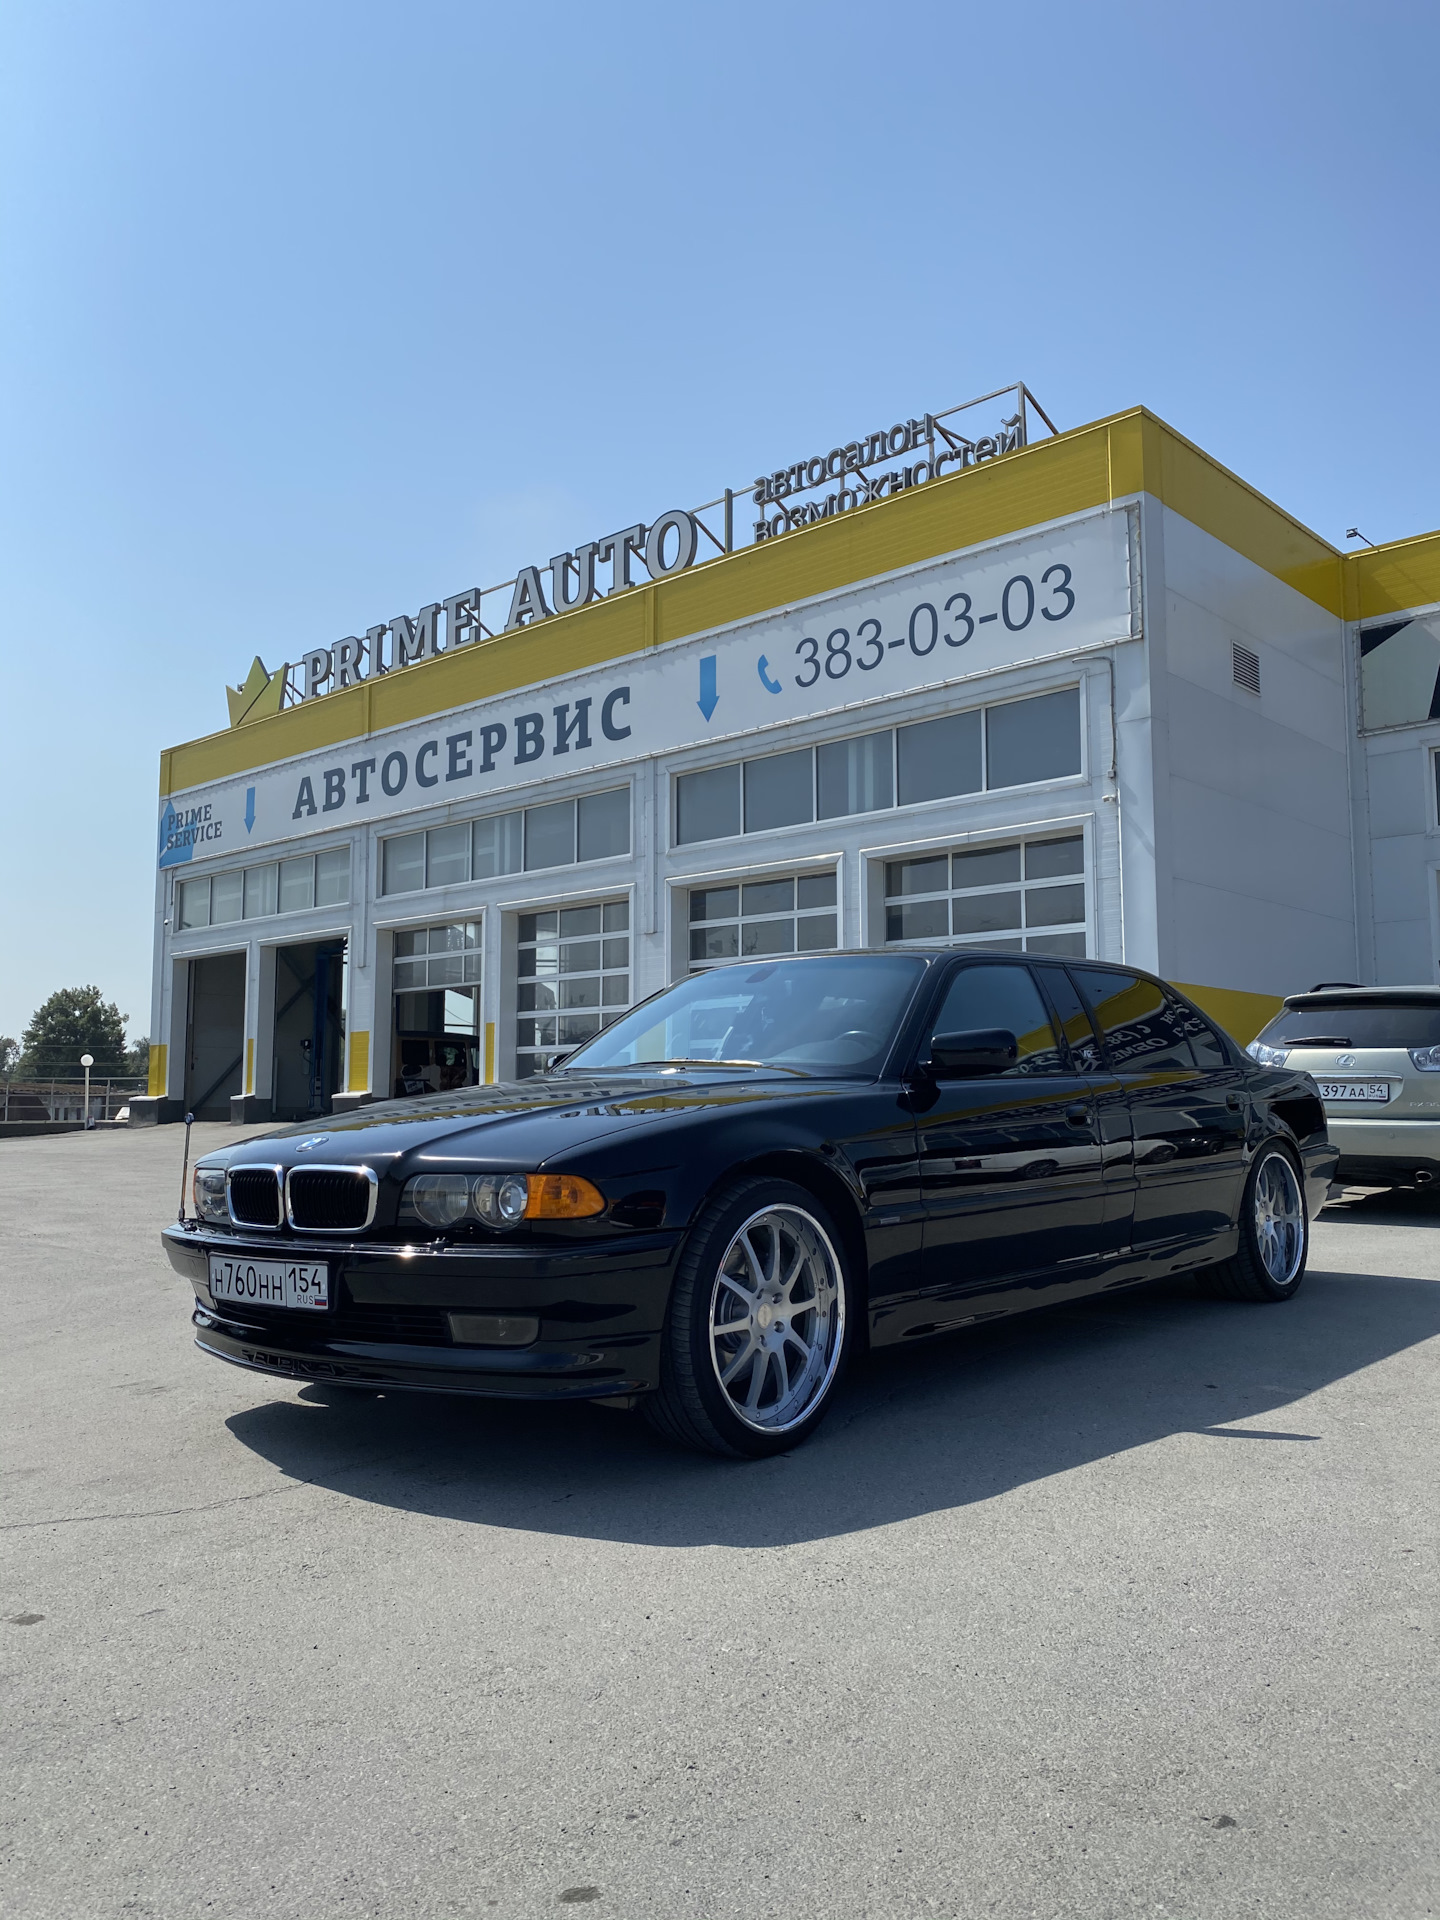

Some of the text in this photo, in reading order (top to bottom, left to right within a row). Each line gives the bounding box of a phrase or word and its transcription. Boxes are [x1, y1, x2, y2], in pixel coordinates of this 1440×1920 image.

[753, 413, 936, 504] автосалон
[753, 413, 1025, 544] возможностей
[302, 509, 698, 701] PRIME AUTO
[794, 563, 1076, 688] 383-03-03
[292, 686, 632, 820] АВТОСЕРВИС
[166, 821, 223, 850] SERVICE
[167, 803, 212, 832] PRIME
[288, 1267, 322, 1295] 154
[296, 1294, 314, 1305] RUS
